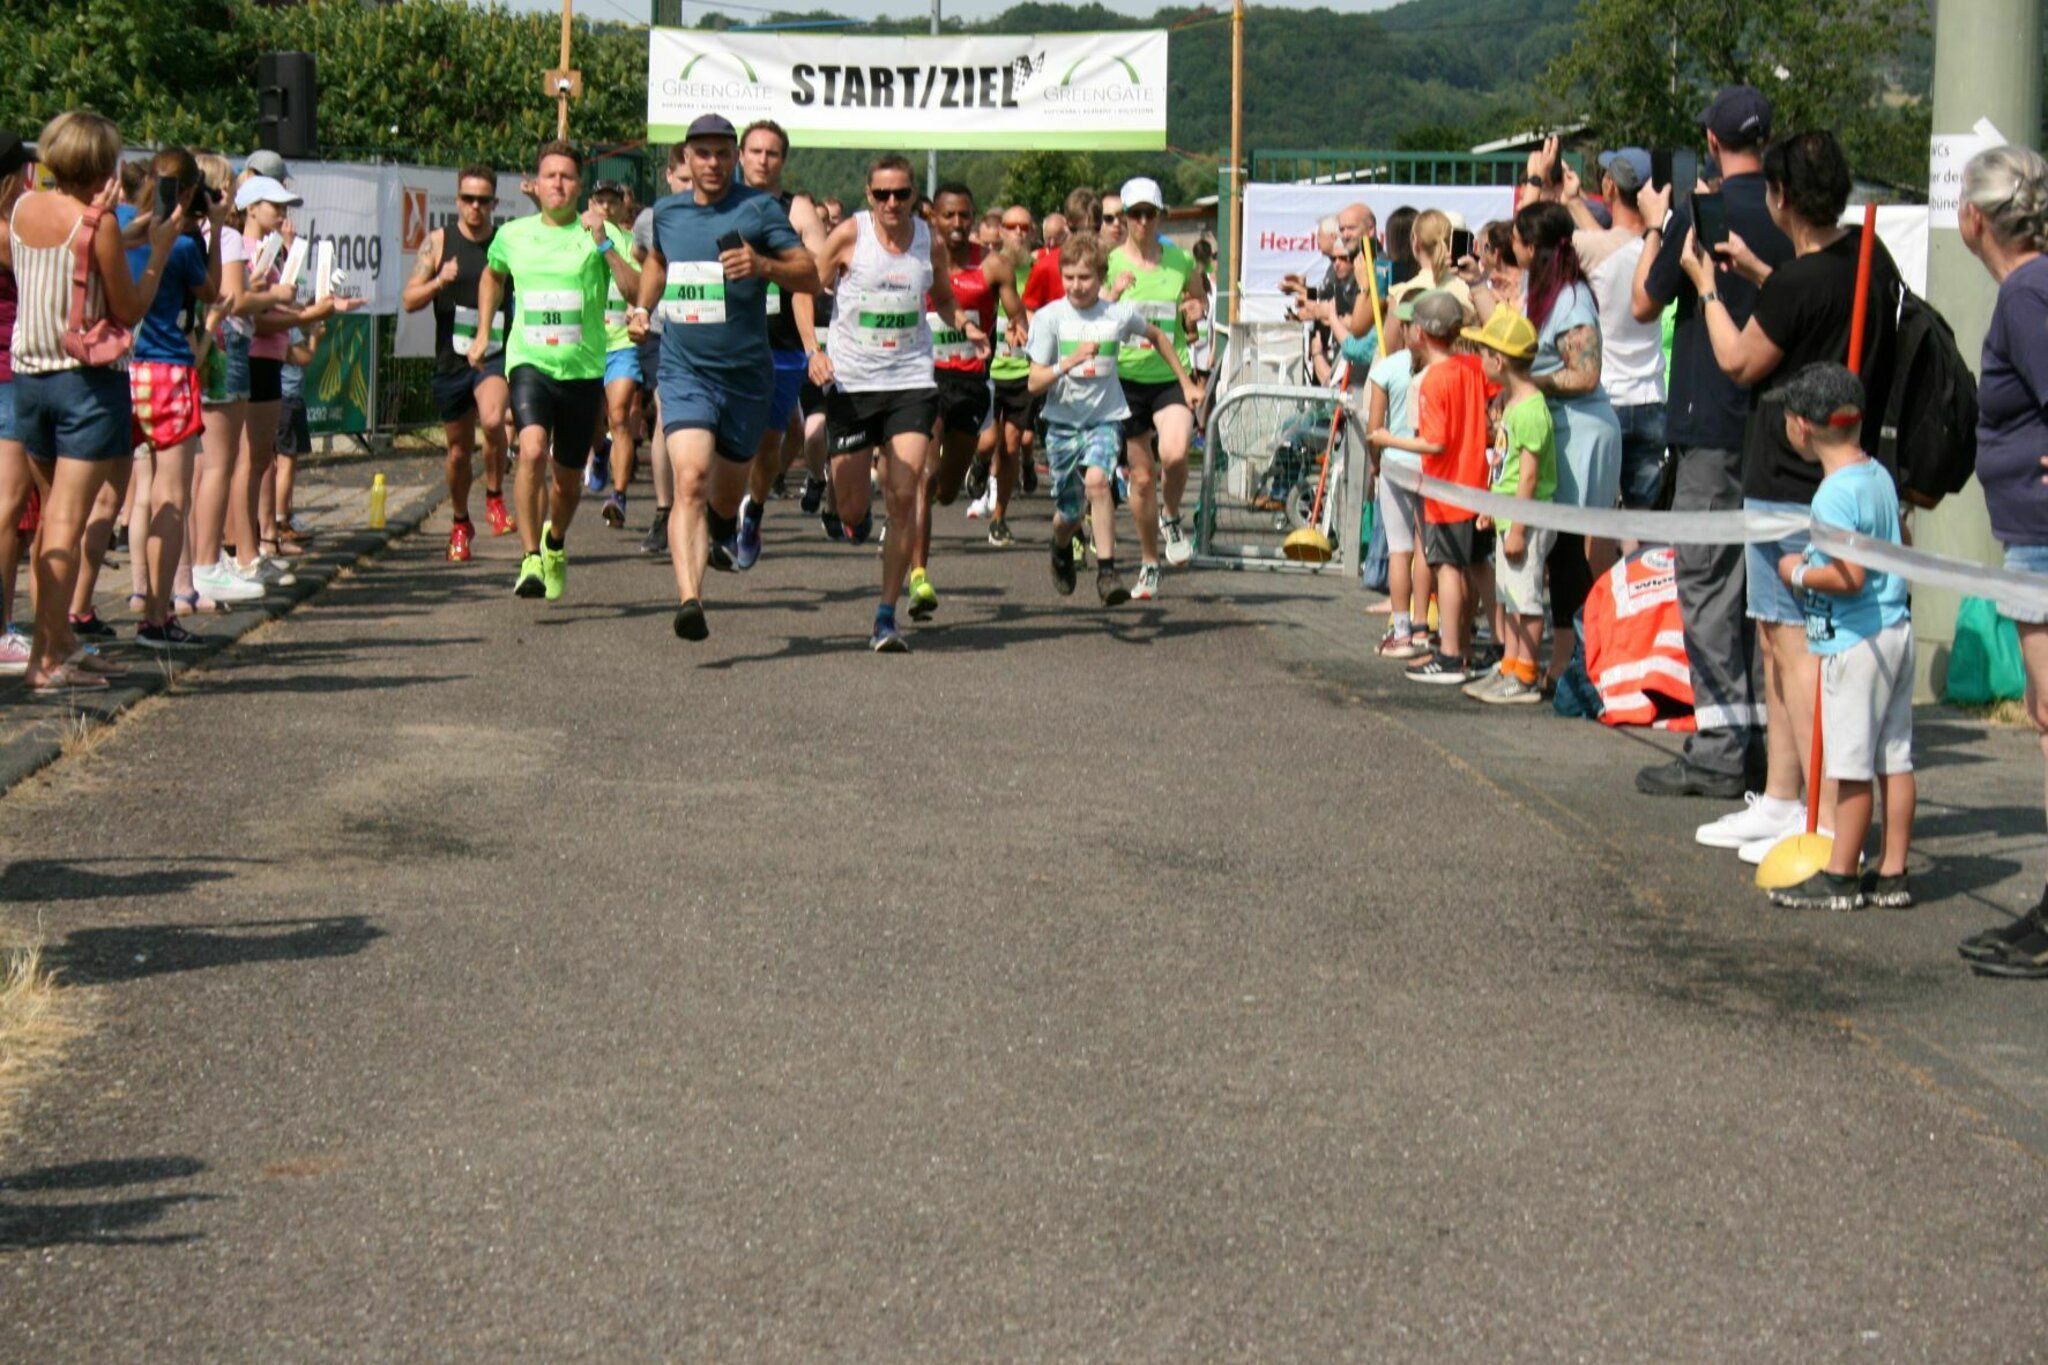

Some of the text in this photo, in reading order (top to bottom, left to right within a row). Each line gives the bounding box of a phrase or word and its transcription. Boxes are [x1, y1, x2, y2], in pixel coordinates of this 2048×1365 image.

[791, 63, 1018, 108] START/ZIEL
[677, 285, 705, 300] 401
[542, 312, 562, 326] 38
[876, 313, 906, 328] 228
